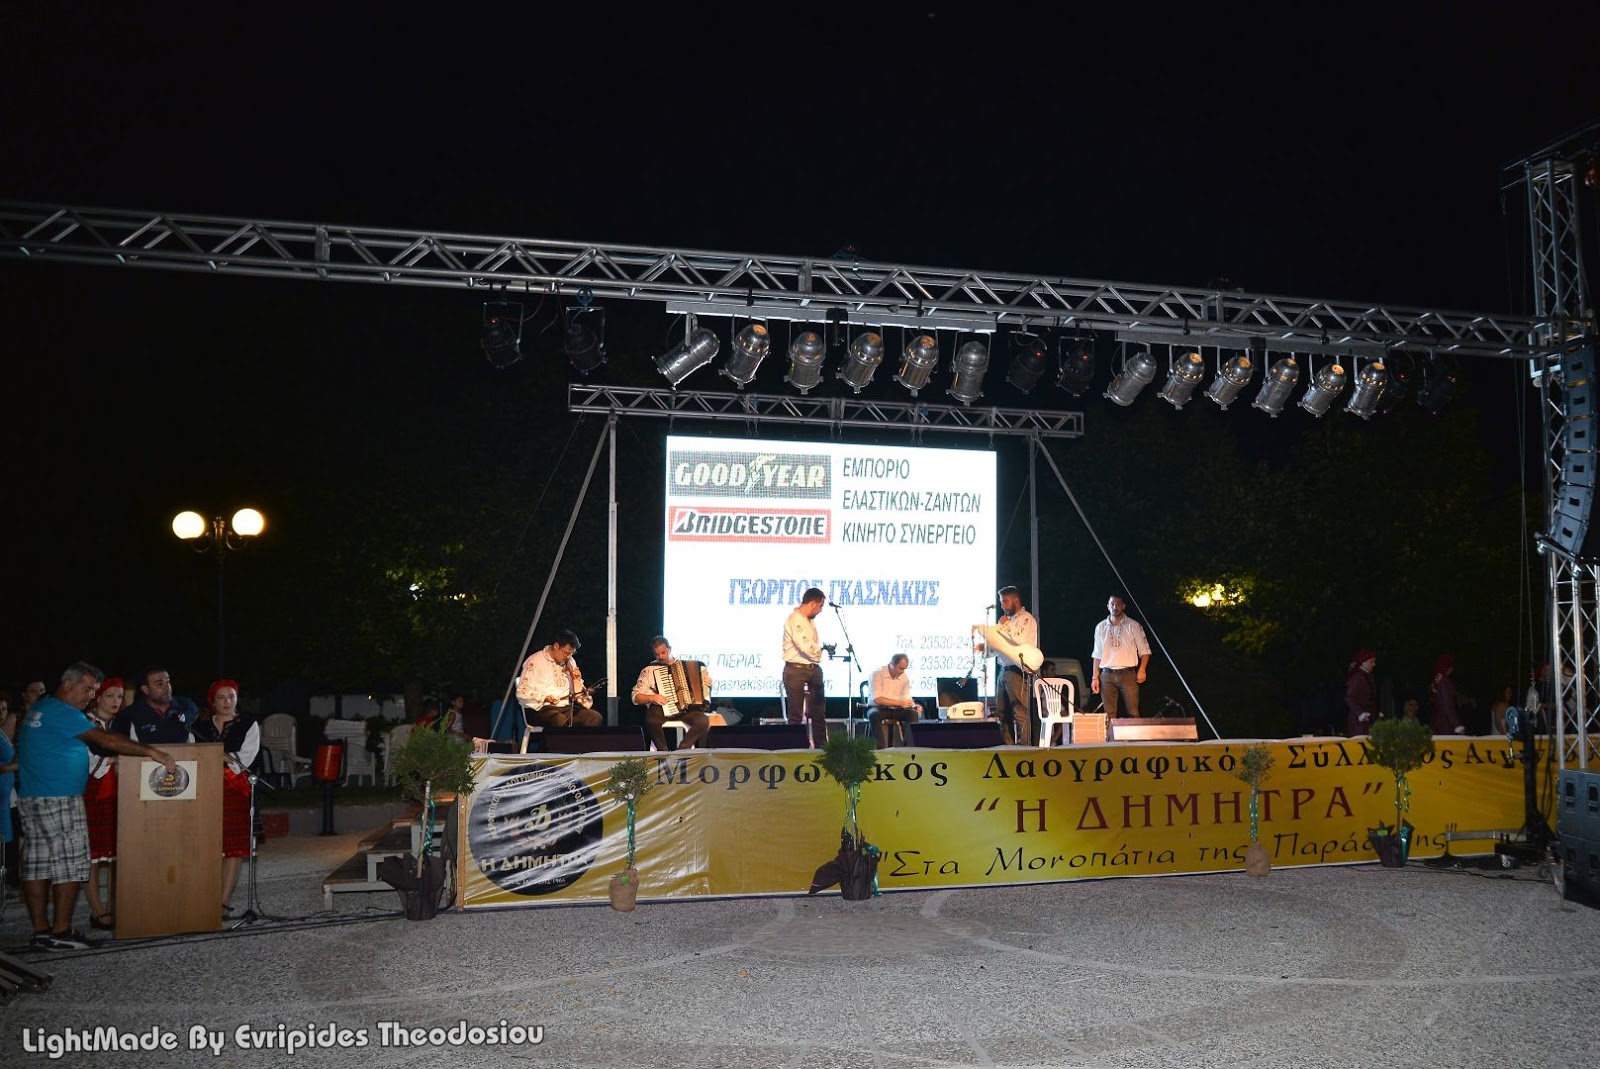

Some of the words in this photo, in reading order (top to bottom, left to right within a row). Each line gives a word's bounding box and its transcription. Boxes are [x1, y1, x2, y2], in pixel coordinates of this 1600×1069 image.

[842, 457, 910, 479] ΕΜΠΟΡΙΟ
[842, 490, 981, 513] ΕΛΑΣΤΙΚΩΝ-ΖΑΝΤΩΝ
[674, 510, 825, 536] BRIDGESTONE
[842, 523, 896, 544] ΚΙΝΗΤΟ
[899, 523, 976, 545] ΣΥΝΕΡΓΕΙΟ
[829, 579, 940, 606] ΓΚΑΣΝΑΚΗΣ
[716, 653, 763, 669] ΠΙΕΡΙΑΣ
[653, 753, 948, 790] Μορφωκός
[982, 746, 1244, 783] Λαογραφικό
[1288, 741, 1454, 769] Σύλλος
[1199, 841, 1250, 863] της
